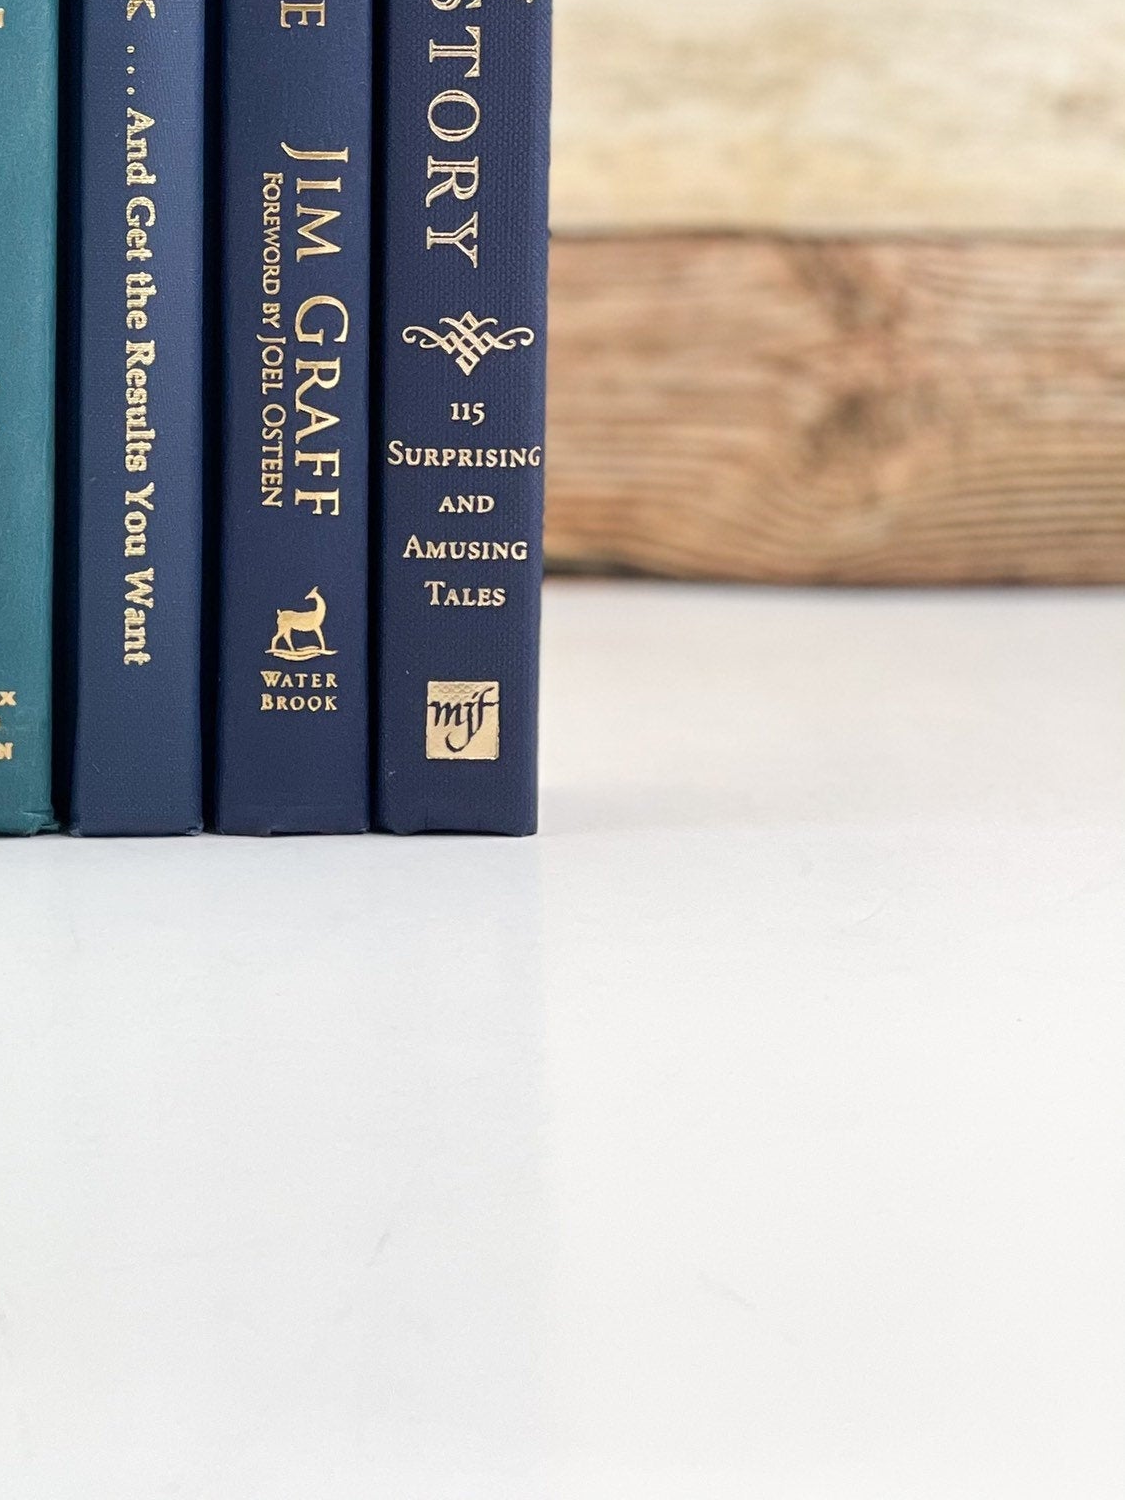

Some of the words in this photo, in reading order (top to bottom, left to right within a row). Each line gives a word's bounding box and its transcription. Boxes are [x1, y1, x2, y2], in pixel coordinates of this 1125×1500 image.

[126, 107, 156, 185] And
[126, 197, 156, 261] Get
[281, 142, 348, 262] JIM
[263, 173, 283, 294] FOREWORD
[126, 272, 157, 329] the
[263, 303, 280, 328] BY
[257, 334, 286, 394] JOEL
[126, 340, 155, 471] Results
[295, 295, 348, 515] GRAFF
[451, 403, 484, 425] 115
[262, 404, 286, 507] OSTEEN
[387, 440, 542, 469] SURPRISING
[125, 482, 154, 557] You
[439, 495, 494, 513] AND
[403, 535, 527, 560] AMUSING
[124, 568, 154, 665] Want
[424, 581, 505, 606] TALES
[261, 671, 337, 687] WATER
[261, 694, 337, 711] BROOK
[428, 687, 499, 753] mjf
